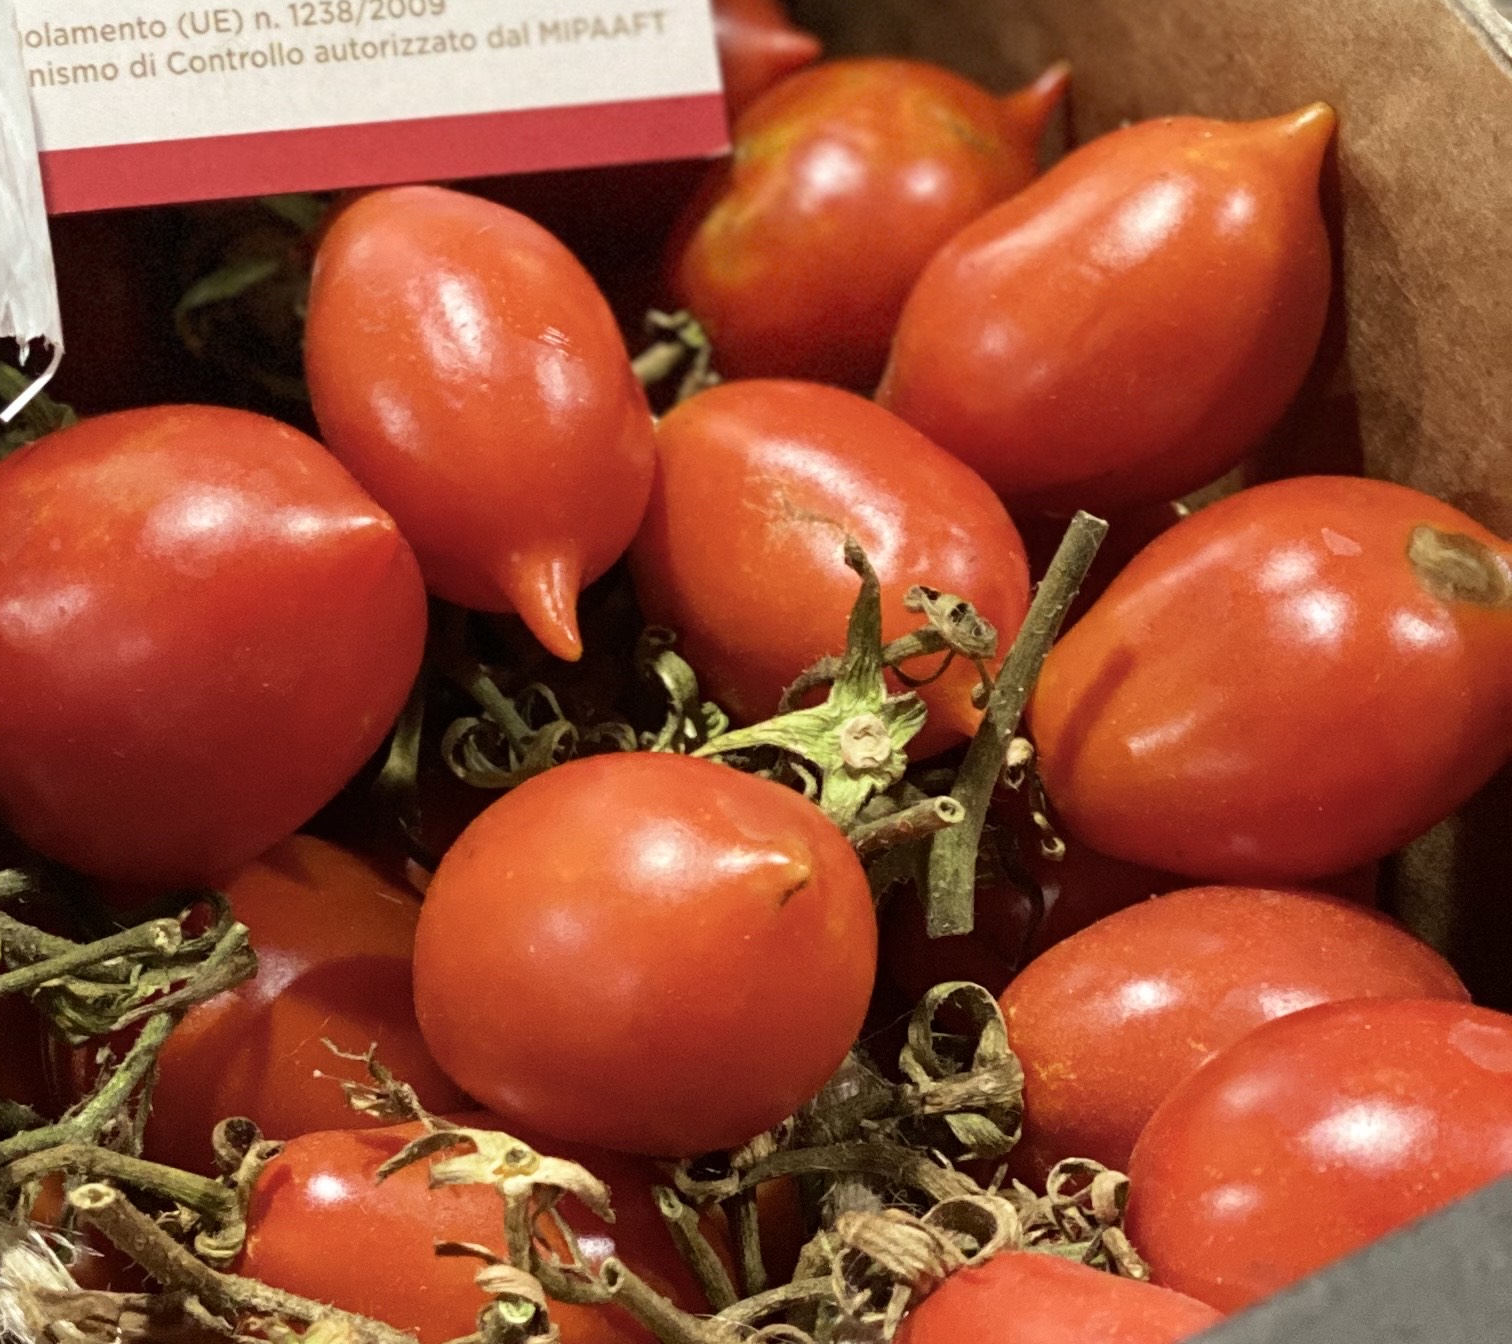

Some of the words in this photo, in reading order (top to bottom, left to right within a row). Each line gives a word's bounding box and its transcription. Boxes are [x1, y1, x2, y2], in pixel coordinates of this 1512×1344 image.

[17, 16, 167, 49] olamento
[178, 8, 244, 40] (UE)
[255, 9, 281, 30] n.
[29, 59, 119, 88] nismo
[129, 52, 157, 78] di
[167, 41, 304, 76] Controllo
[314, 30, 476, 65] autorizzato
[486, 25, 531, 50] dal
[539, 9, 667, 46] MIPAAFT
